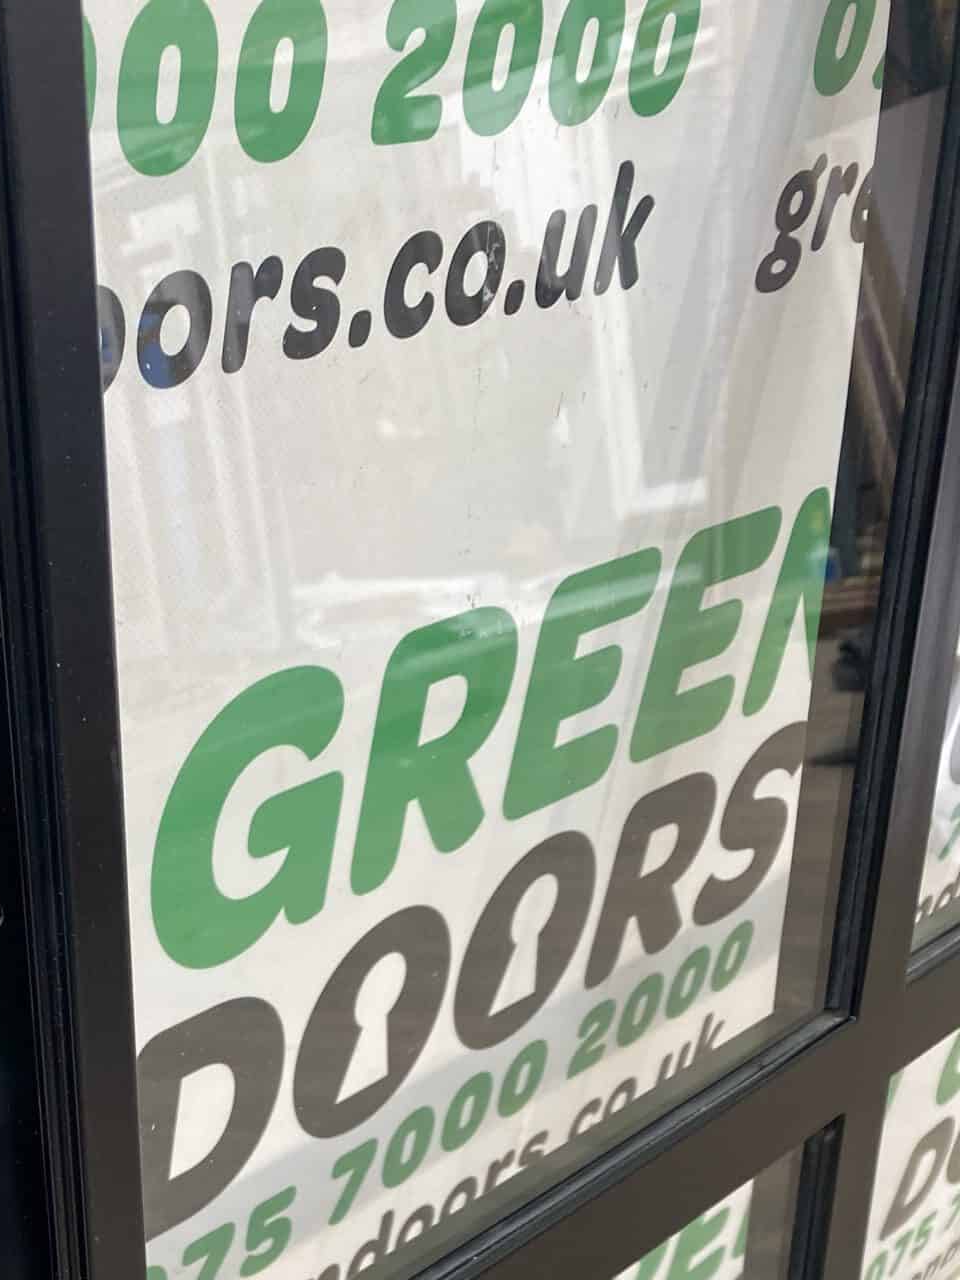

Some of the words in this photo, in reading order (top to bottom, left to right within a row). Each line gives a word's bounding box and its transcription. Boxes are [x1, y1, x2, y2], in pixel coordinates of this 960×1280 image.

[83, 0, 329, 177] 00
[370, 0, 702, 146] 2000
[813, 0, 884, 97] 0
[136, 721, 808, 1240] DOORS
[328, 1039, 549, 1226] 7000
[566, 921, 755, 1080] 2000
